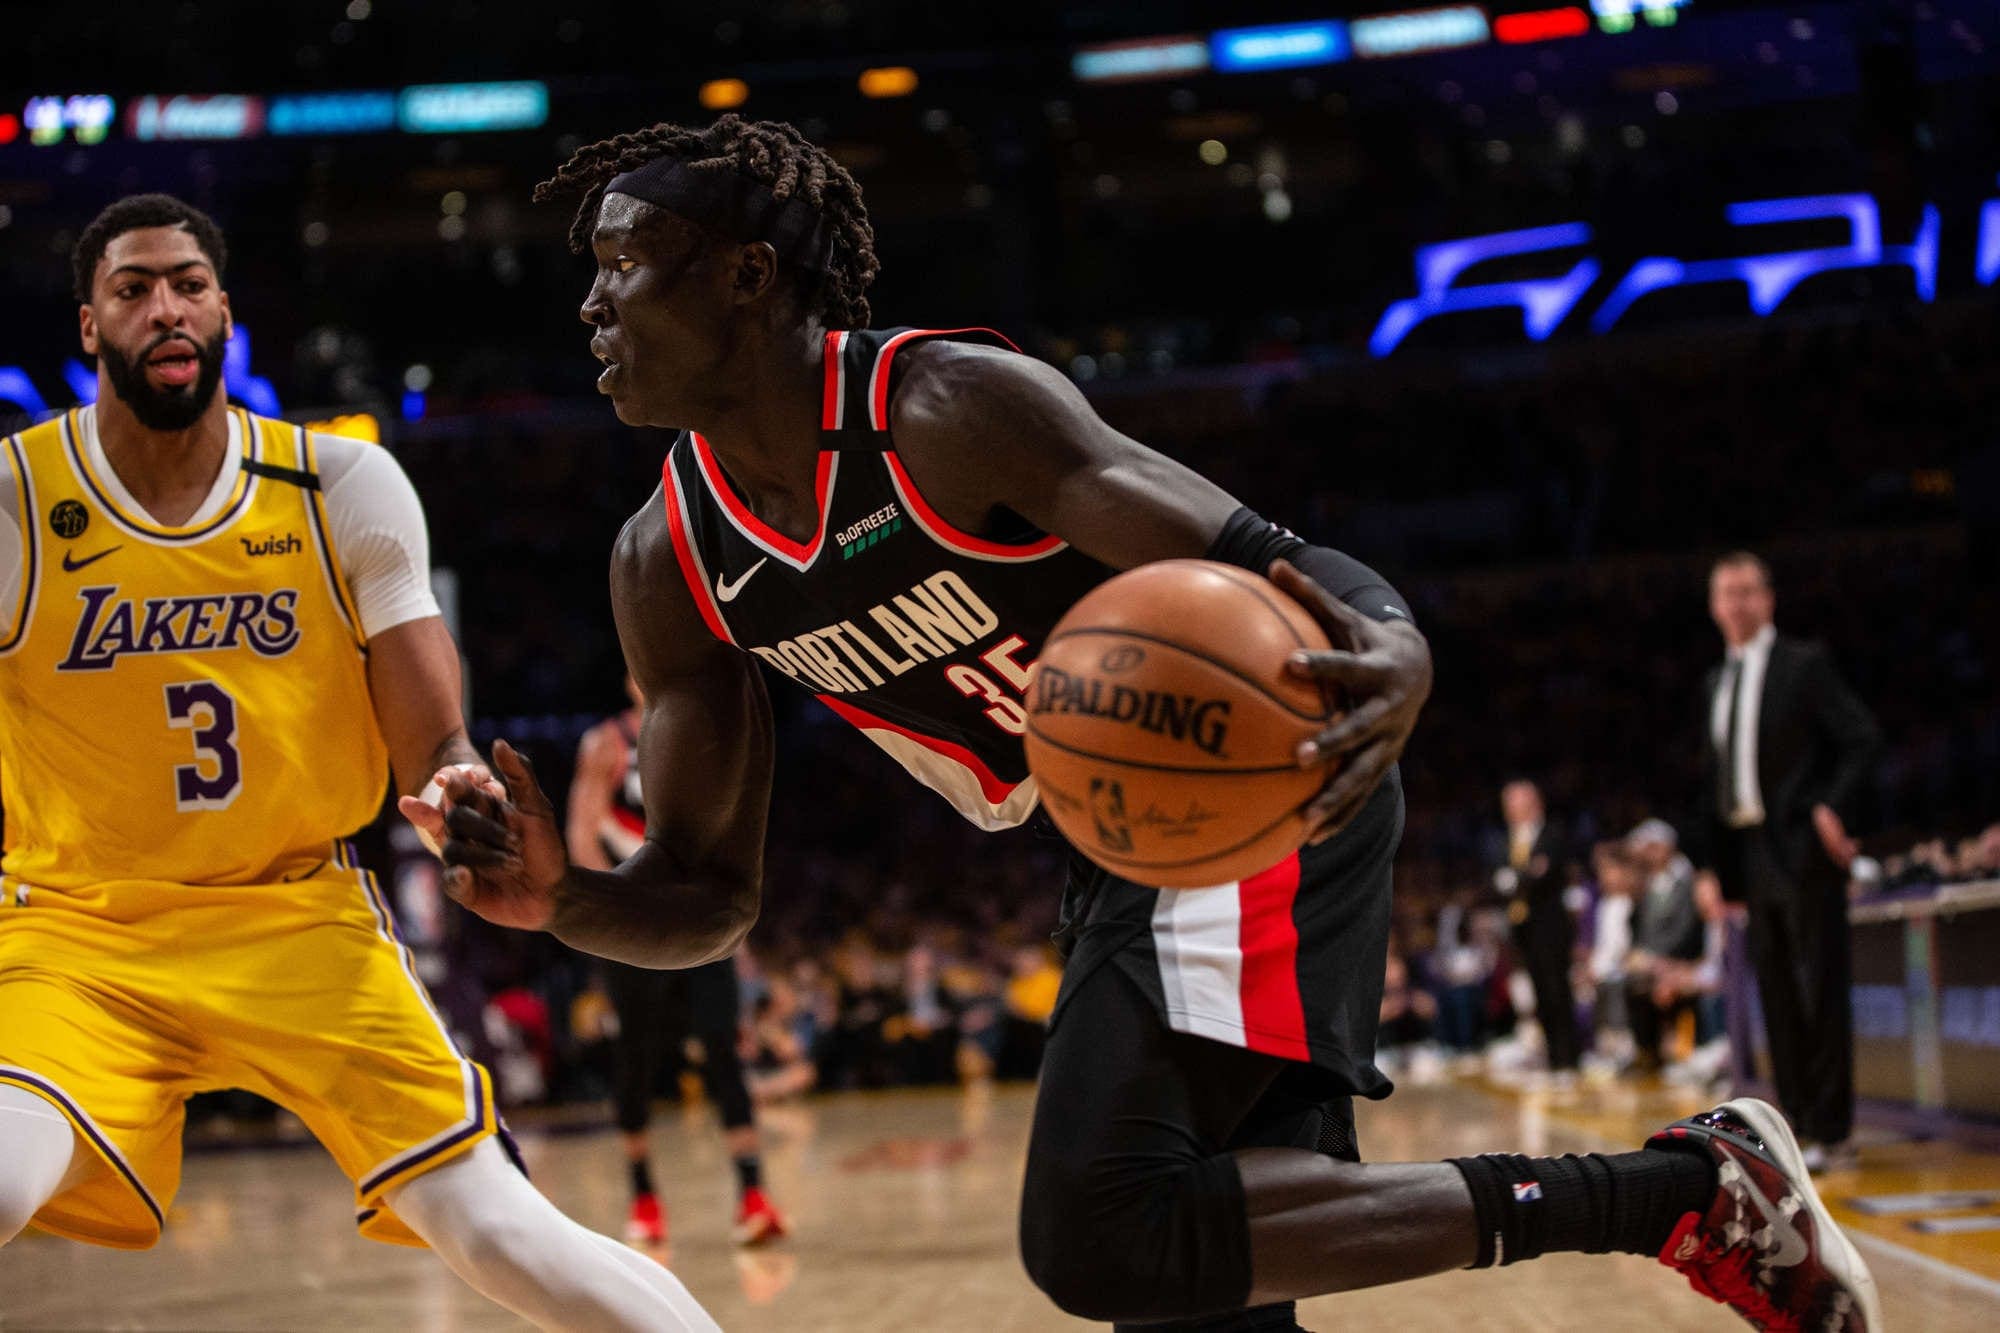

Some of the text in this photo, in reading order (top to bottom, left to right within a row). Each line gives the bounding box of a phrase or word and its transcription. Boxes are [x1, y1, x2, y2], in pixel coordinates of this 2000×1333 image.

[240, 532, 302, 556] wish
[55, 585, 301, 673] LAKERS
[748, 570, 999, 694] PORTLAND
[163, 677, 243, 813] 3
